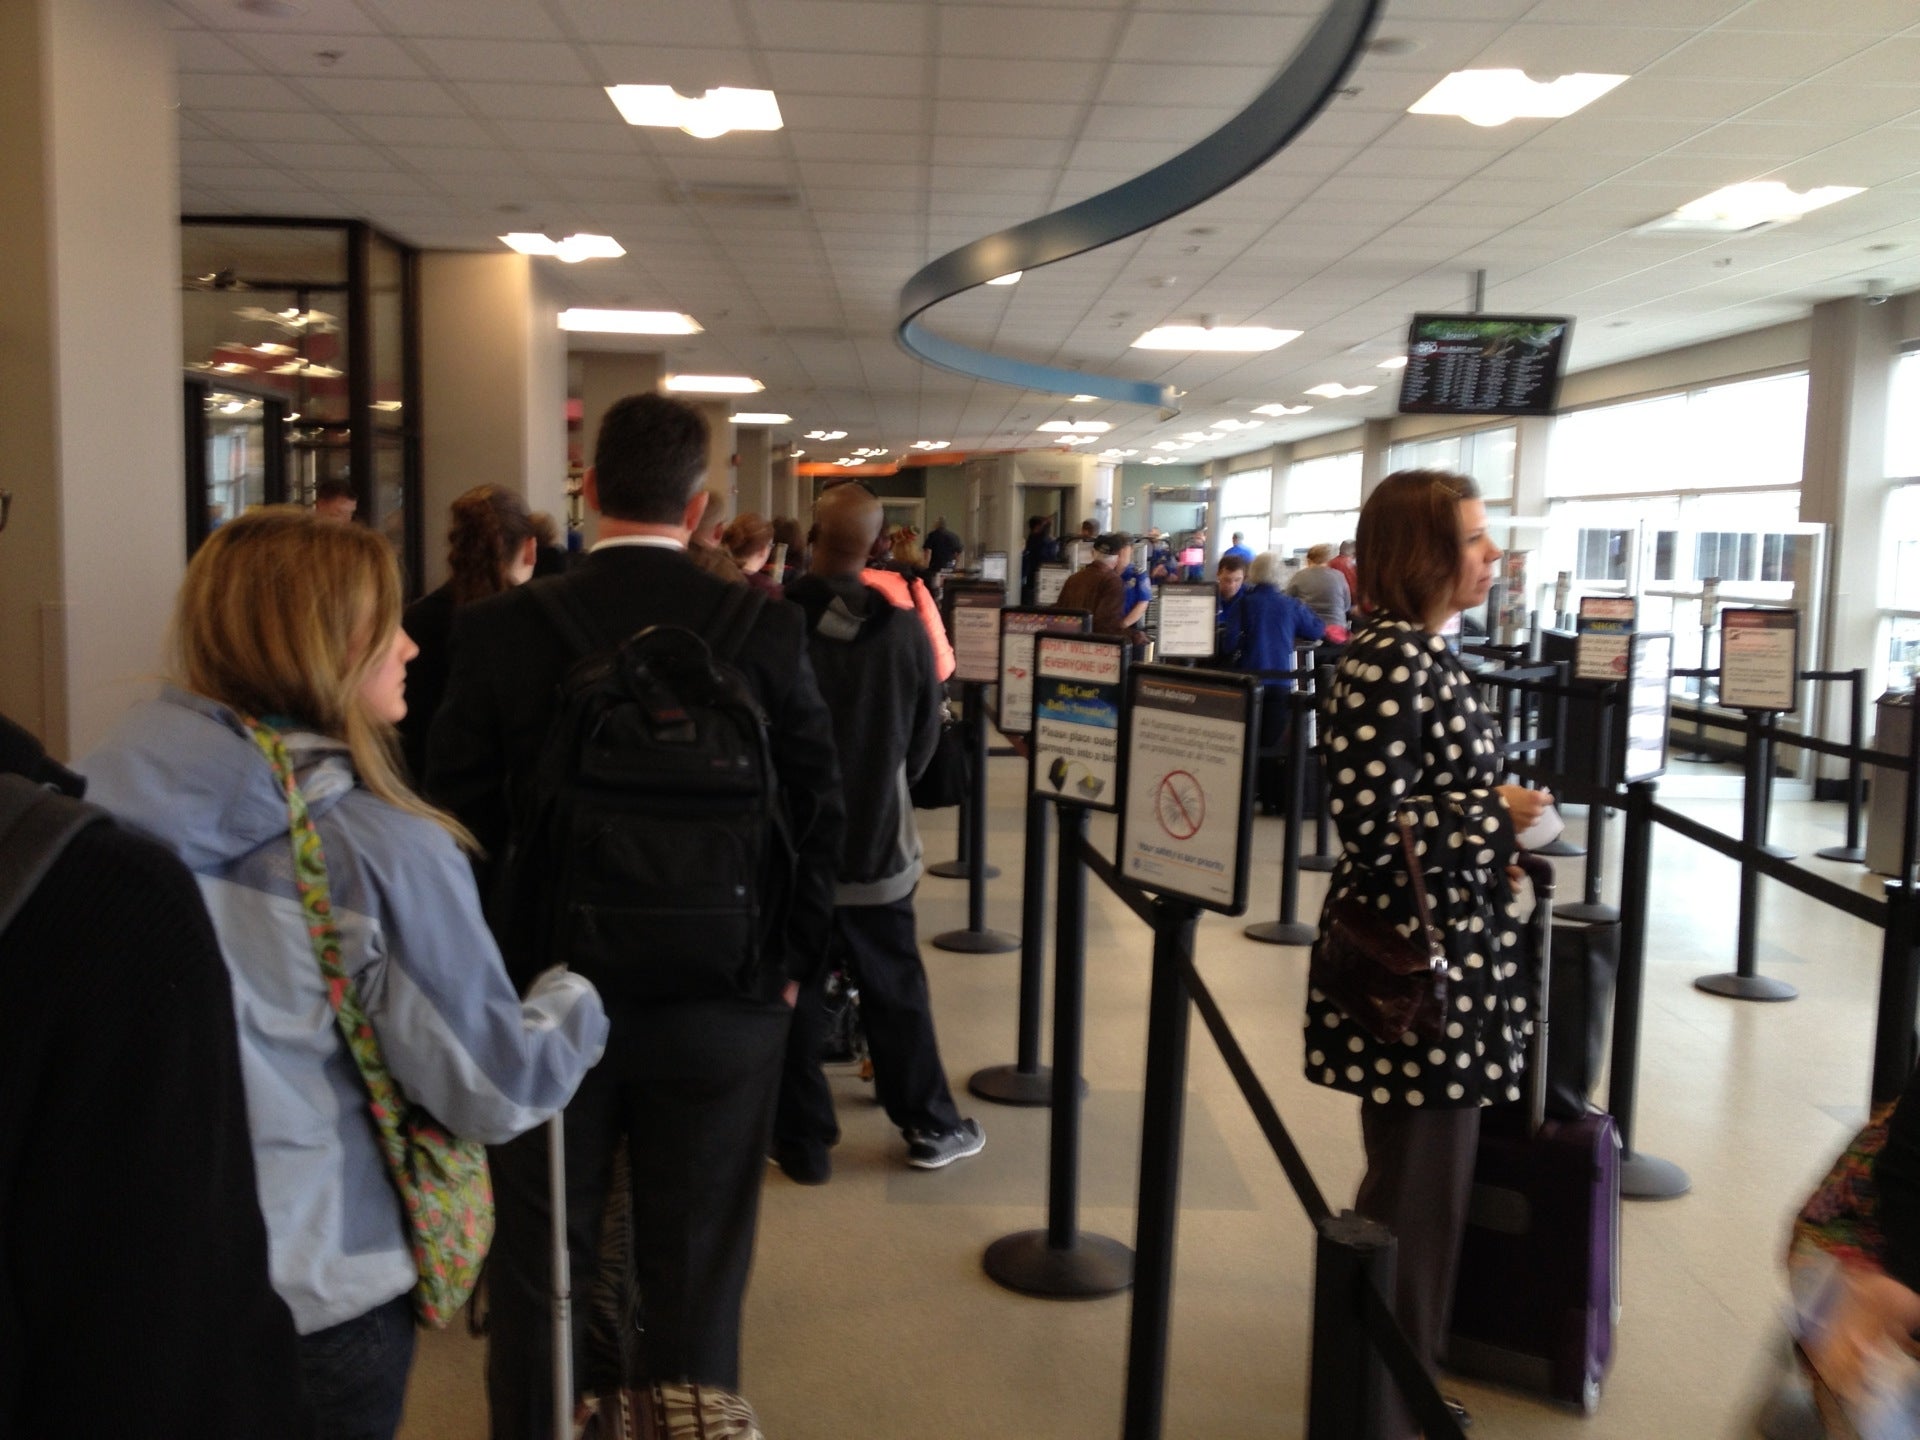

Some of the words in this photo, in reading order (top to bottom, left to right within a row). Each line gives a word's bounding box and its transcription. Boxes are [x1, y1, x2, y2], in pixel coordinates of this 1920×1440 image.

[1040, 640, 1066, 652] WHAT
[1068, 643, 1093, 655] WILL
[1045, 656, 1096, 673] EVERYONE
[1099, 662, 1118, 674] UP?
[1141, 685, 1164, 697] Travel
[1165, 689, 1198, 704] Advisory
[1042, 726, 1067, 739] Please
[1070, 732, 1091, 743] place
[1094, 737, 1117, 748] outer
[1037, 742, 1075, 756] garments
[1138, 841, 1153, 852] Your
